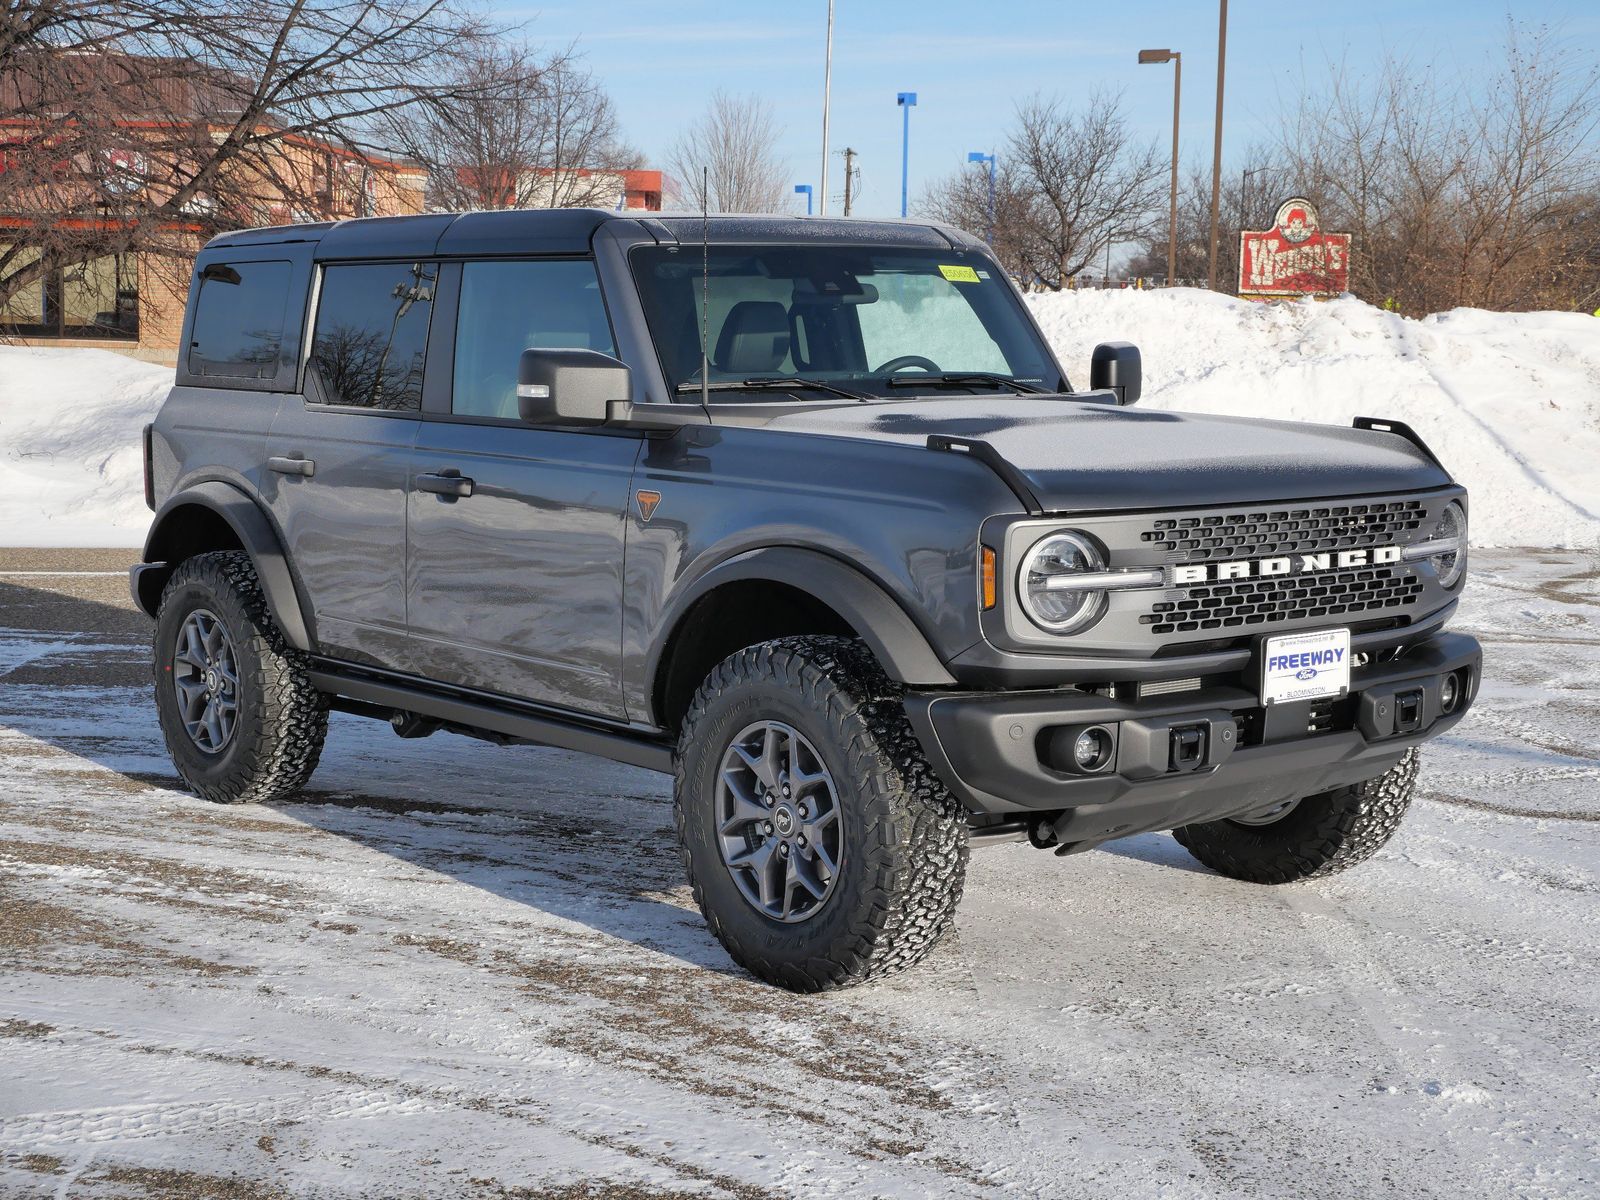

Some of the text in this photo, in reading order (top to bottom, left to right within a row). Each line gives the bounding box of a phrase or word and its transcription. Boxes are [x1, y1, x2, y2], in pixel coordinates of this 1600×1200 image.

[1174, 546, 1400, 584] BRONCO
[1269, 648, 1345, 672] FREEWAY
[1298, 669, 1316, 680] Ford
[1287, 686, 1326, 698] BLOOMINGTON
